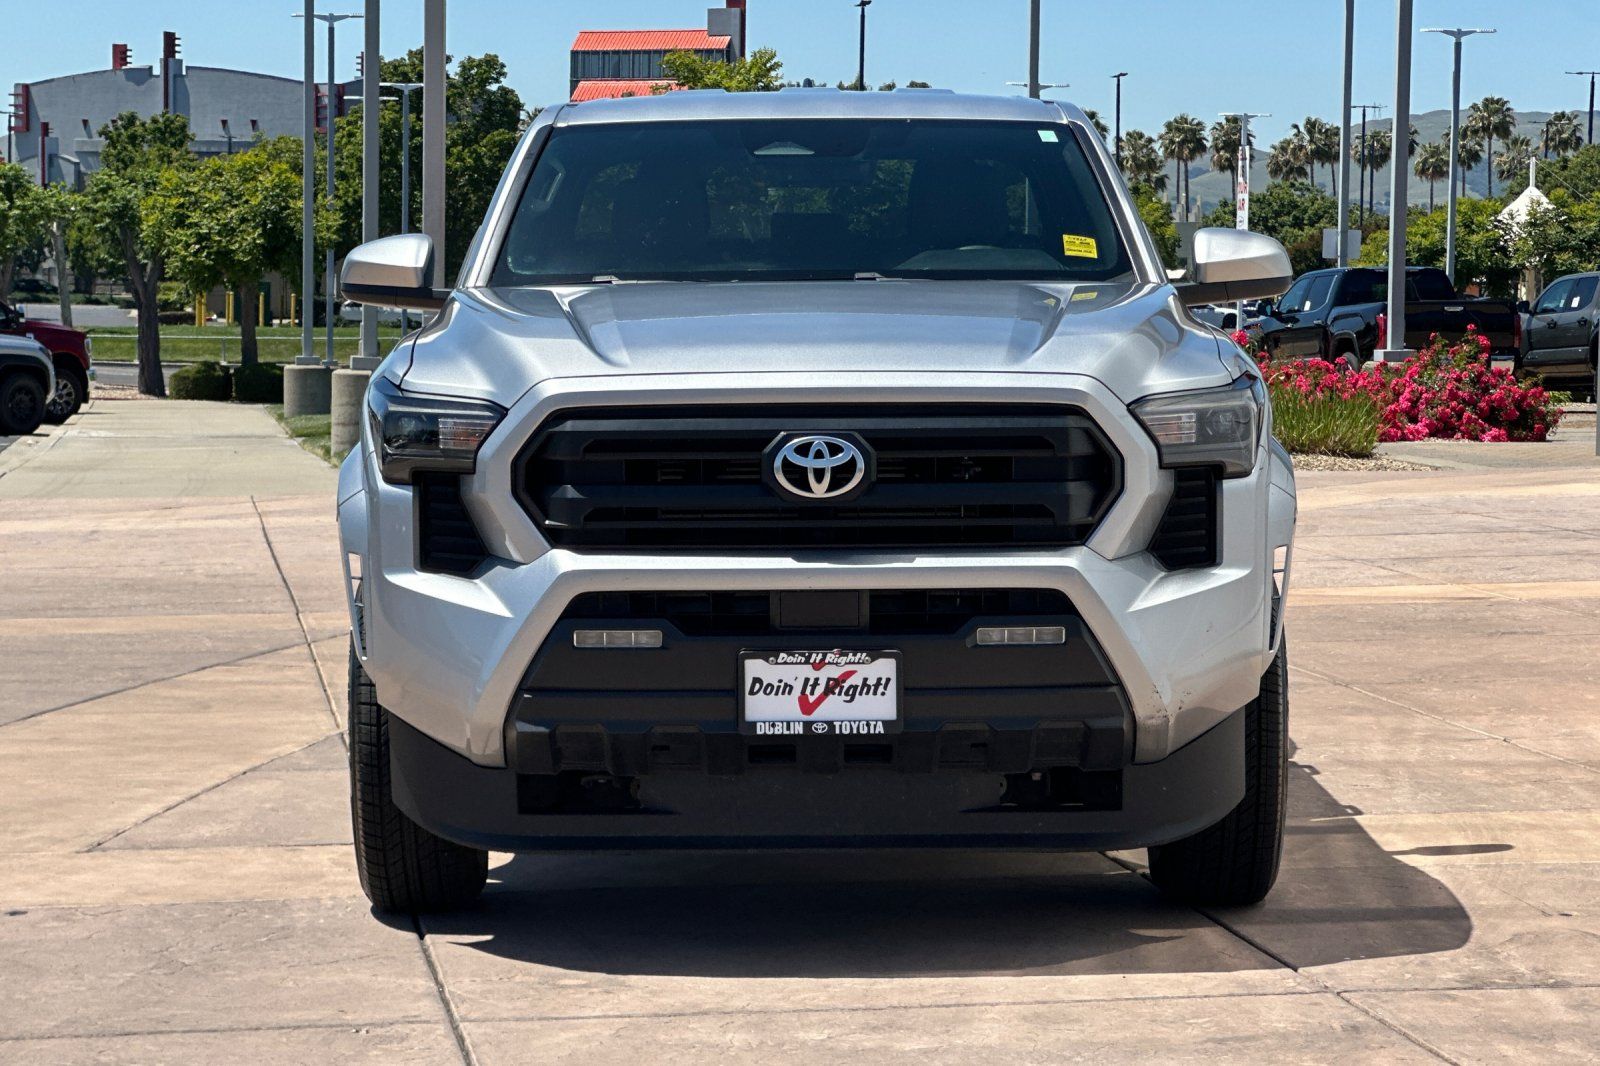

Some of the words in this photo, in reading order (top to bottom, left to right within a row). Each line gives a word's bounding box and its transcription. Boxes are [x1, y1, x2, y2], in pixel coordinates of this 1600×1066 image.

[777, 652, 808, 664] Doin'
[810, 652, 823, 664] It
[824, 652, 867, 667] Right!
[747, 676, 798, 697] Doin'
[800, 677, 820, 696] It
[824, 677, 892, 703] Right!
[756, 721, 804, 735] DUBLIN
[833, 721, 885, 735] TOYOTA
